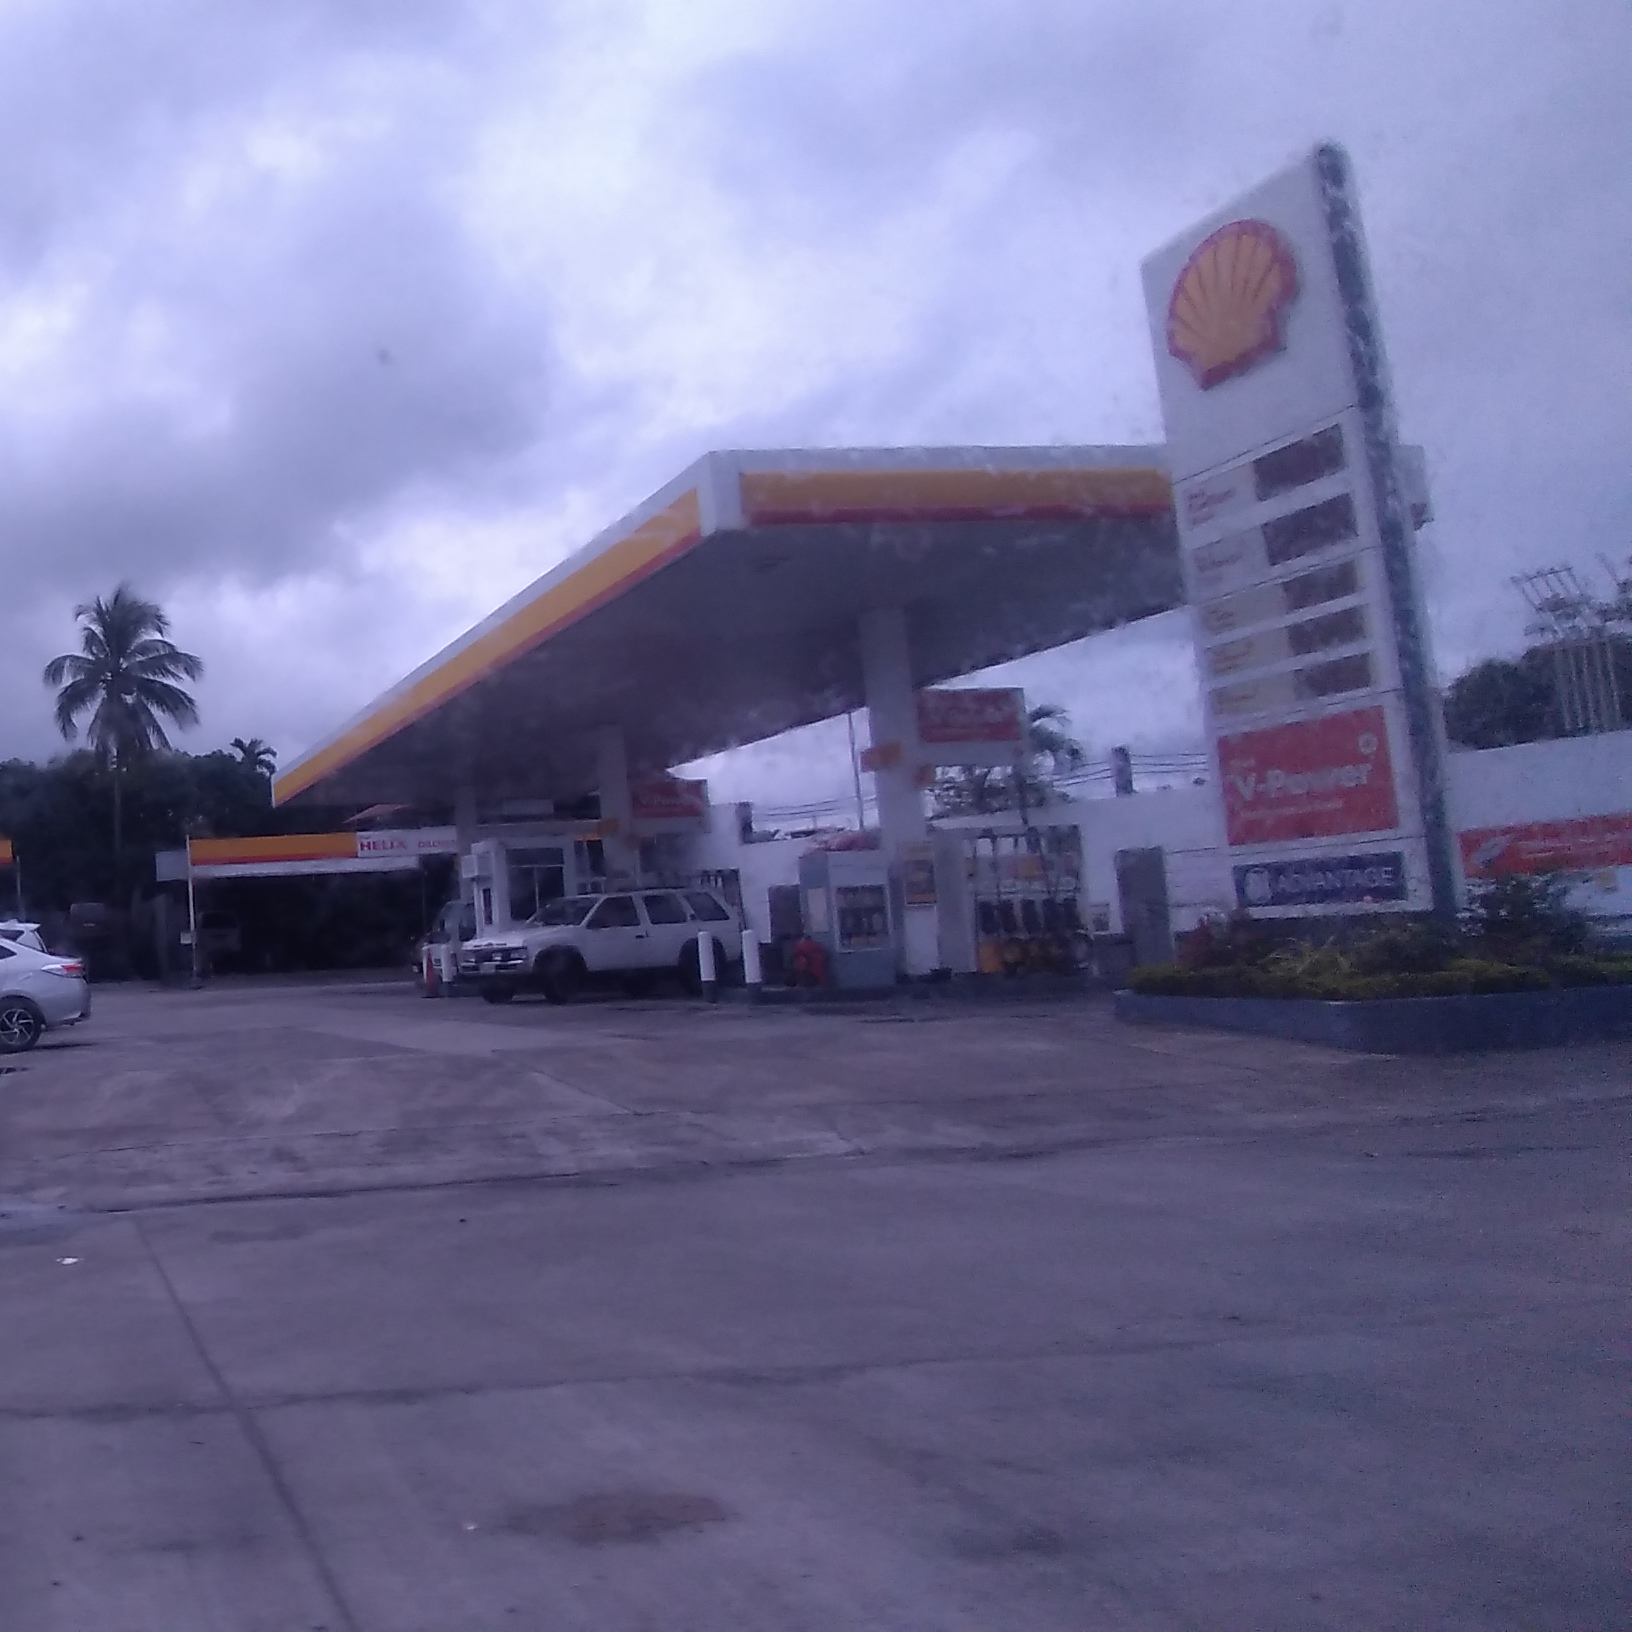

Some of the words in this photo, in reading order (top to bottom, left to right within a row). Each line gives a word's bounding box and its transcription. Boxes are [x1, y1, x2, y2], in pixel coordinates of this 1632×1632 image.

[1226, 763, 1372, 801] V-Power
[360, 841, 407, 851] HELIX
[1278, 867, 1395, 893] ADVANTAGE
